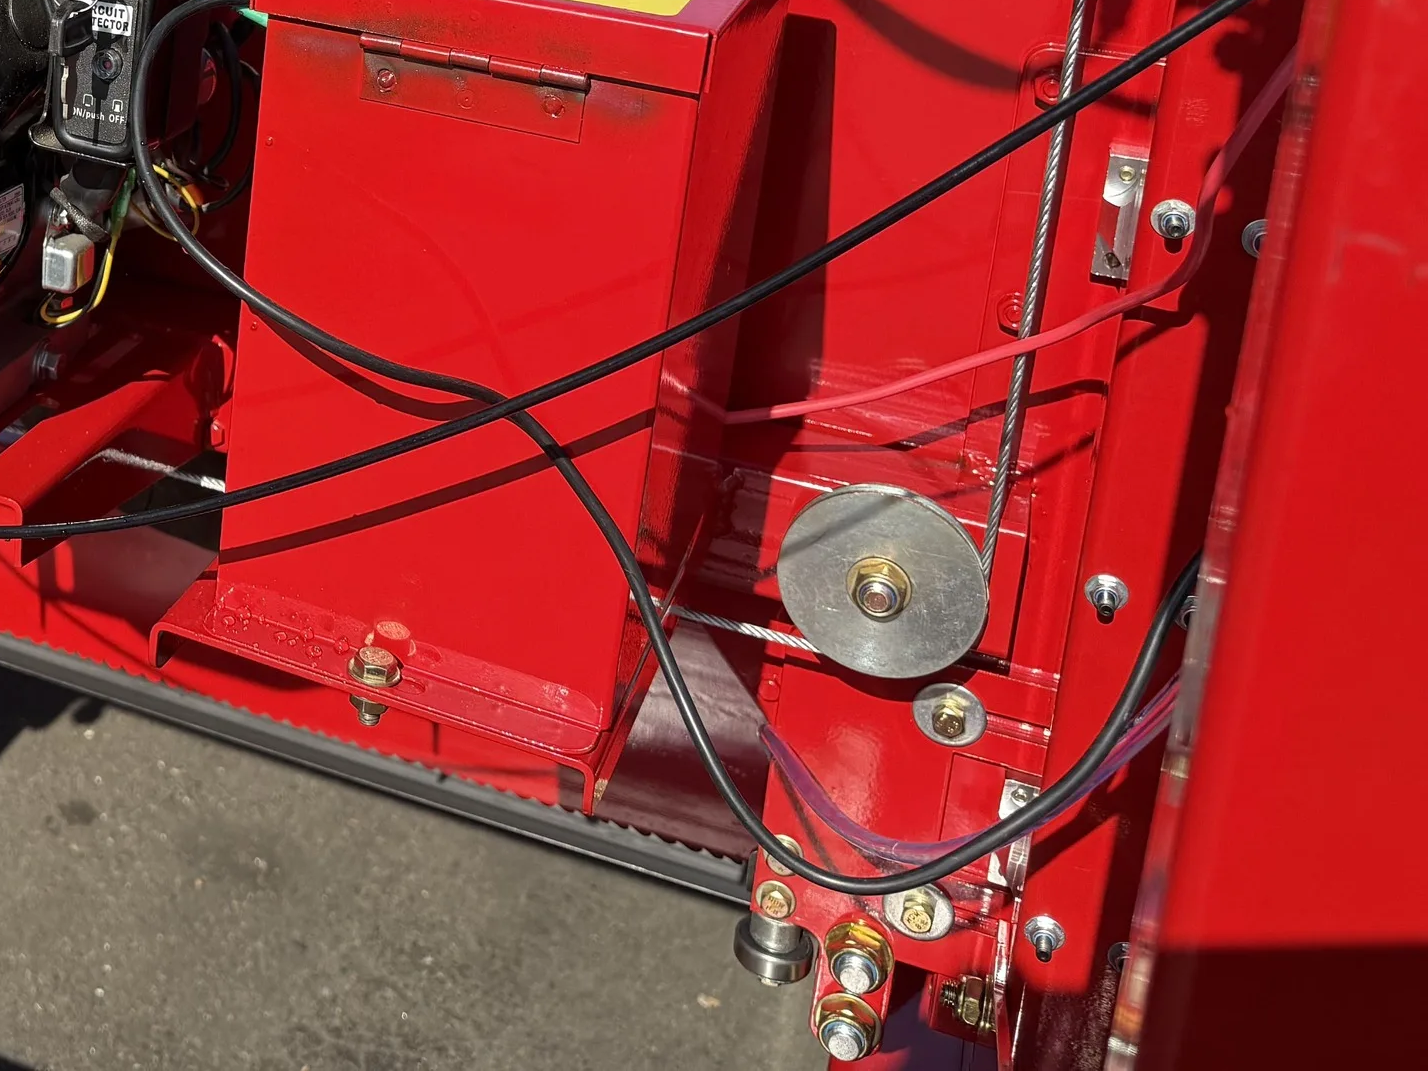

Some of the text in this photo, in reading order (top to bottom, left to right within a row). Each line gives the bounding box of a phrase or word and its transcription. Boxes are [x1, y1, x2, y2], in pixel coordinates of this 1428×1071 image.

[91, 5, 126, 19] RCUIT
[91, 16, 129, 32] TECTOR
[108, 114, 125, 125] OFF
